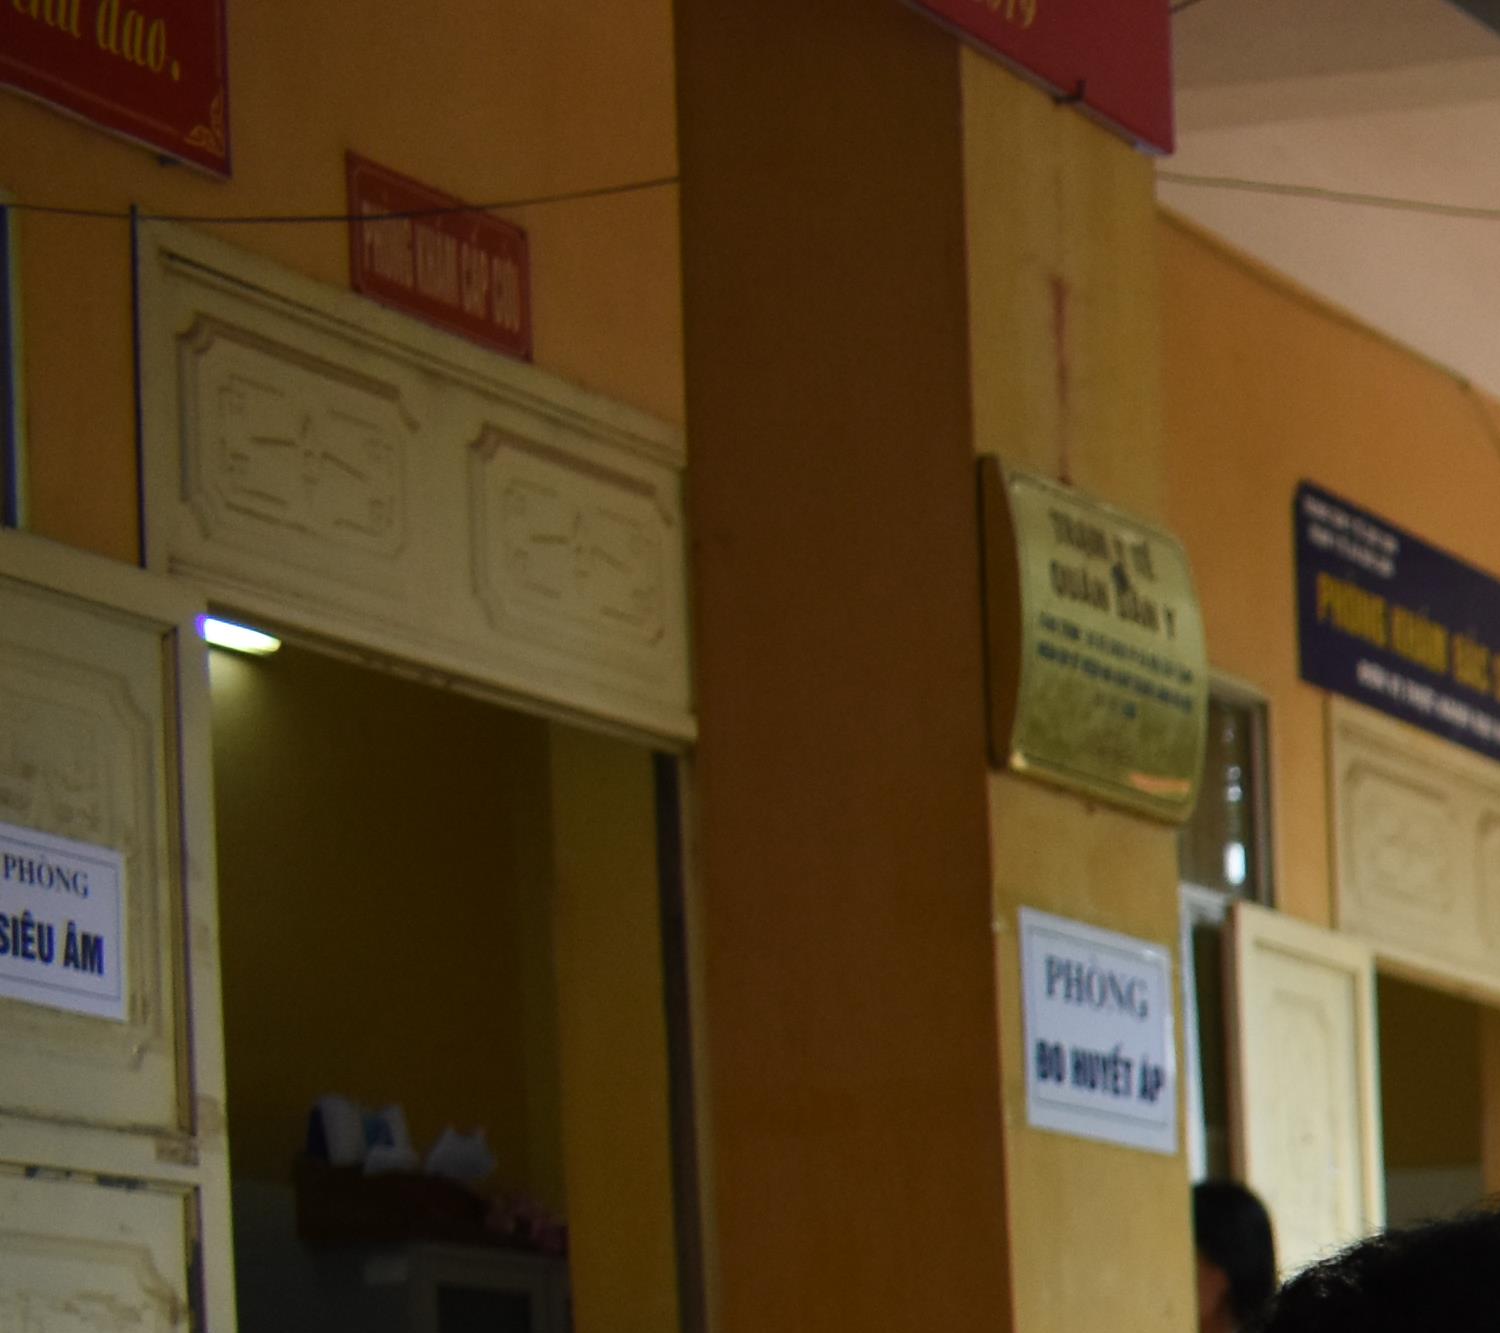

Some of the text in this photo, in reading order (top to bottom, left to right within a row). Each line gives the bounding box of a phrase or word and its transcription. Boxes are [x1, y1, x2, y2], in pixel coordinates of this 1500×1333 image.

[3, 853, 90, 899] PHÒNG
[63, 919, 105, 976] ÂM
[1044, 953, 1149, 1020] PHÒNG
